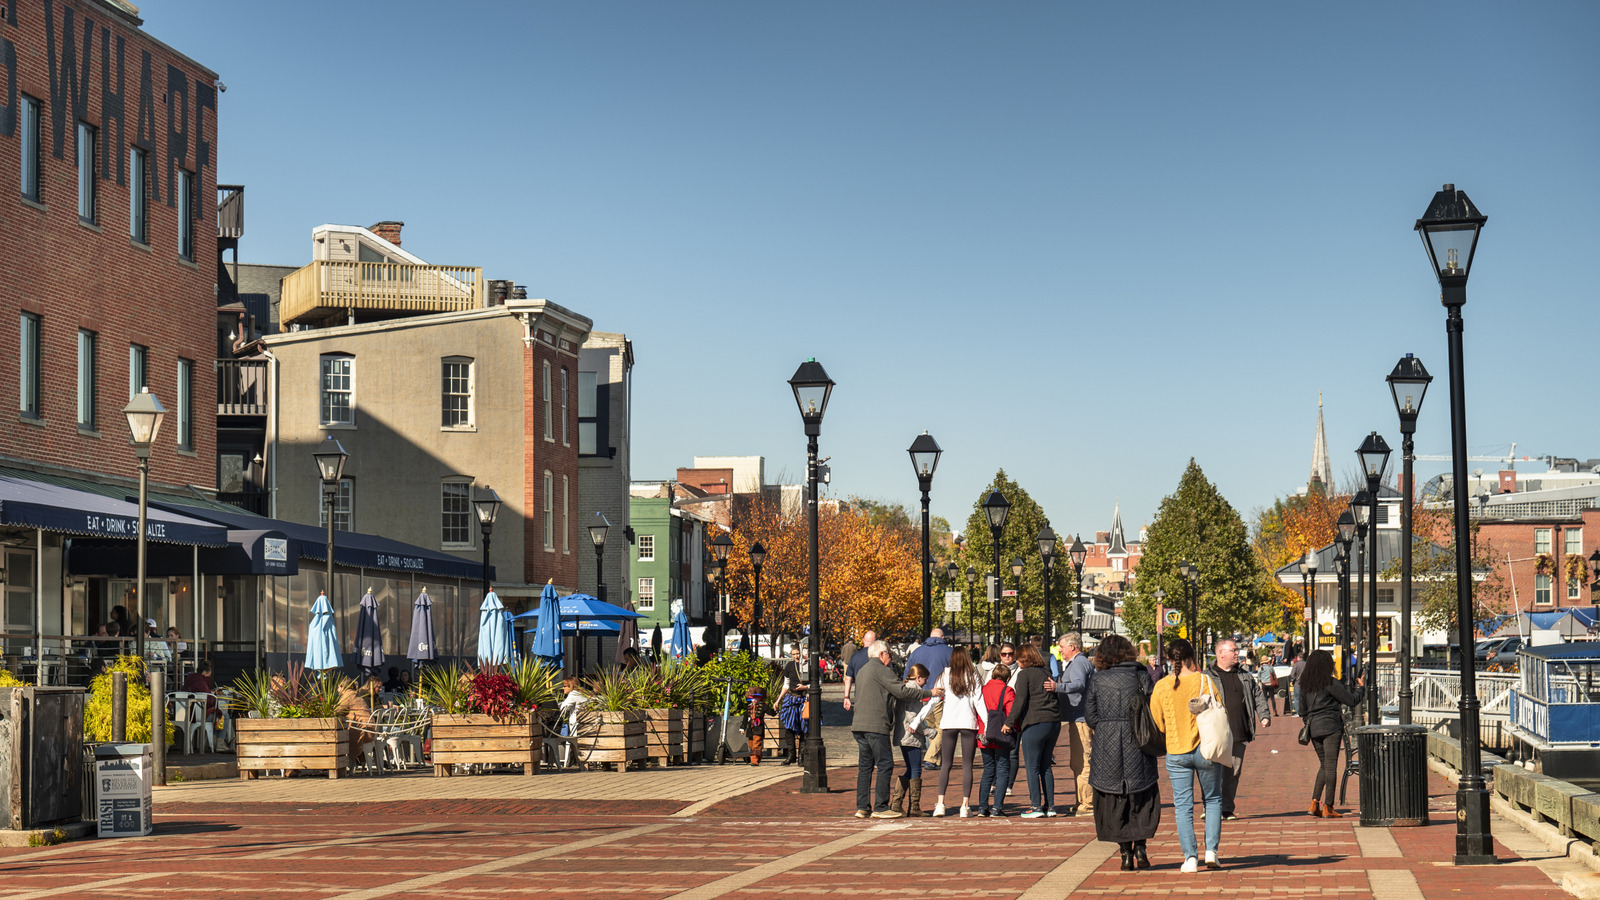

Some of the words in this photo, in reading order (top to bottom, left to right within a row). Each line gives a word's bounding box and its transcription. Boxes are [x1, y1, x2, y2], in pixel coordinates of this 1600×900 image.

[44, 0, 216, 221] WHARF
[87, 515, 99, 530] EAT
[106, 517, 126, 533] DRINK
[132, 520, 165, 537] SOALIZE
[377, 554, 385, 565] EAT
[388, 555, 401, 567] DRINK
[403, 557, 424, 569] SOCIALIZE
[1318, 636, 1337, 644] WATER
[100, 799, 113, 833] TRASH
